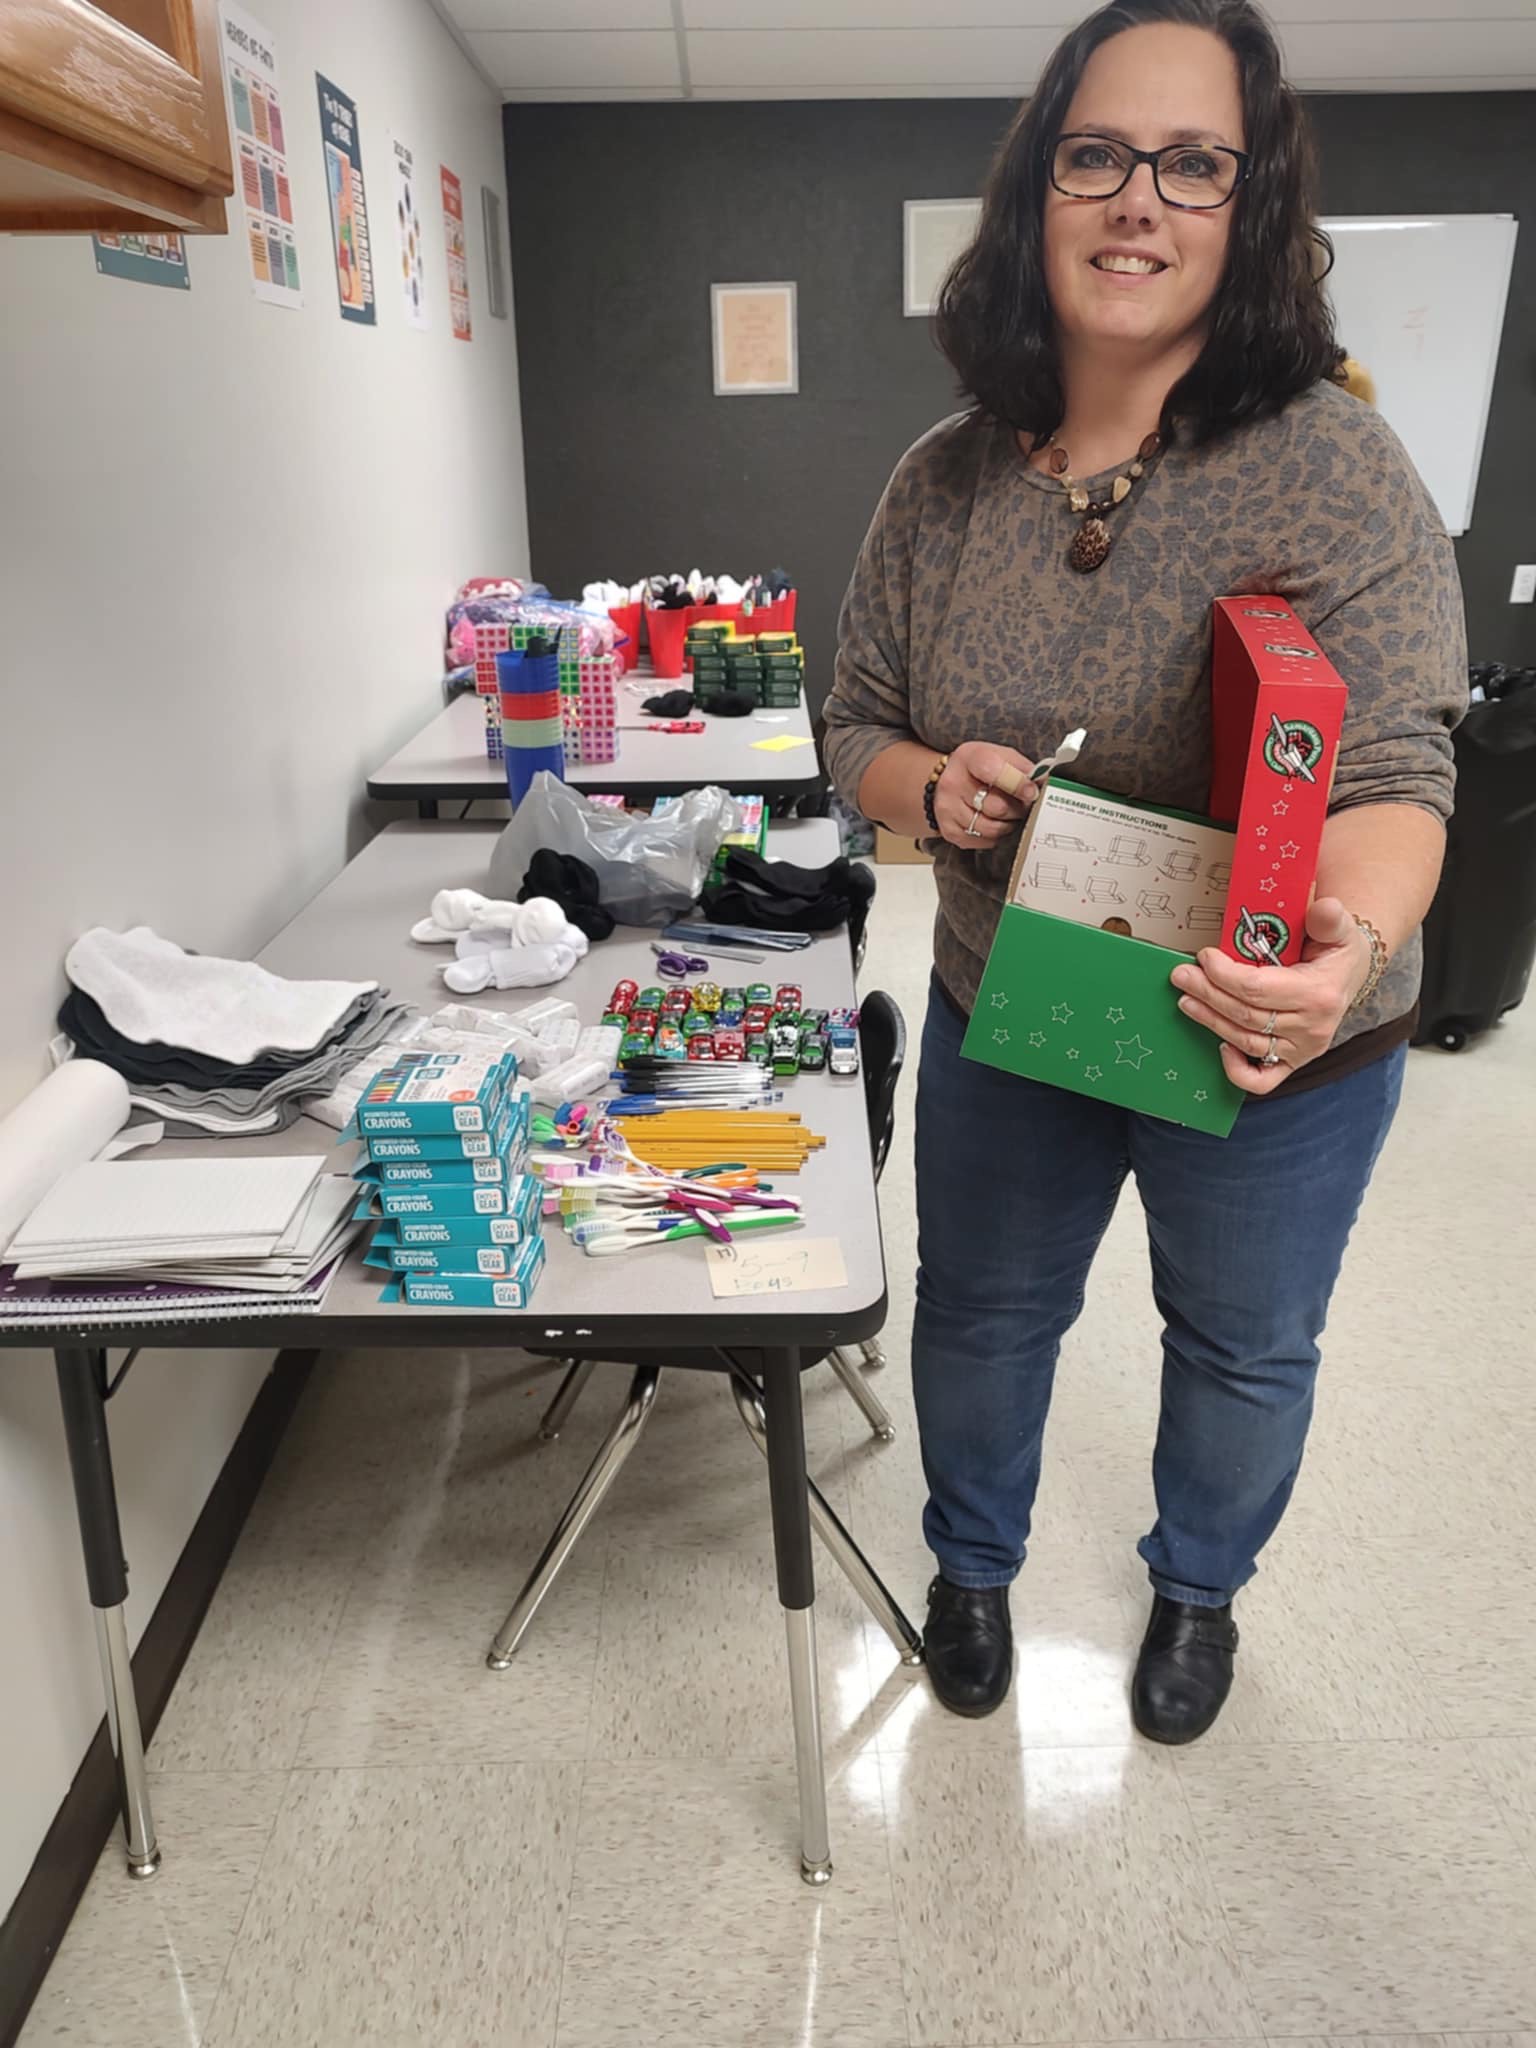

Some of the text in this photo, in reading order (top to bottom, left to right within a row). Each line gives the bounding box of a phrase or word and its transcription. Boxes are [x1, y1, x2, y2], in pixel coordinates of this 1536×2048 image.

[1047, 794, 1098, 812] ASSEMBLY
[1099, 807, 1169, 831] INSTRUCTIONS
[364, 1118, 412, 1129] CRAYONS
[374, 1144, 421, 1156] CRAYONS
[386, 1168, 432, 1180] CRAYONS
[386, 1200, 433, 1212] CRAYONS
[404, 1230, 450, 1242] CRAYONS
[394, 1256, 439, 1268] CRAYONS
[409, 1288, 454, 1301] CRAYONS
